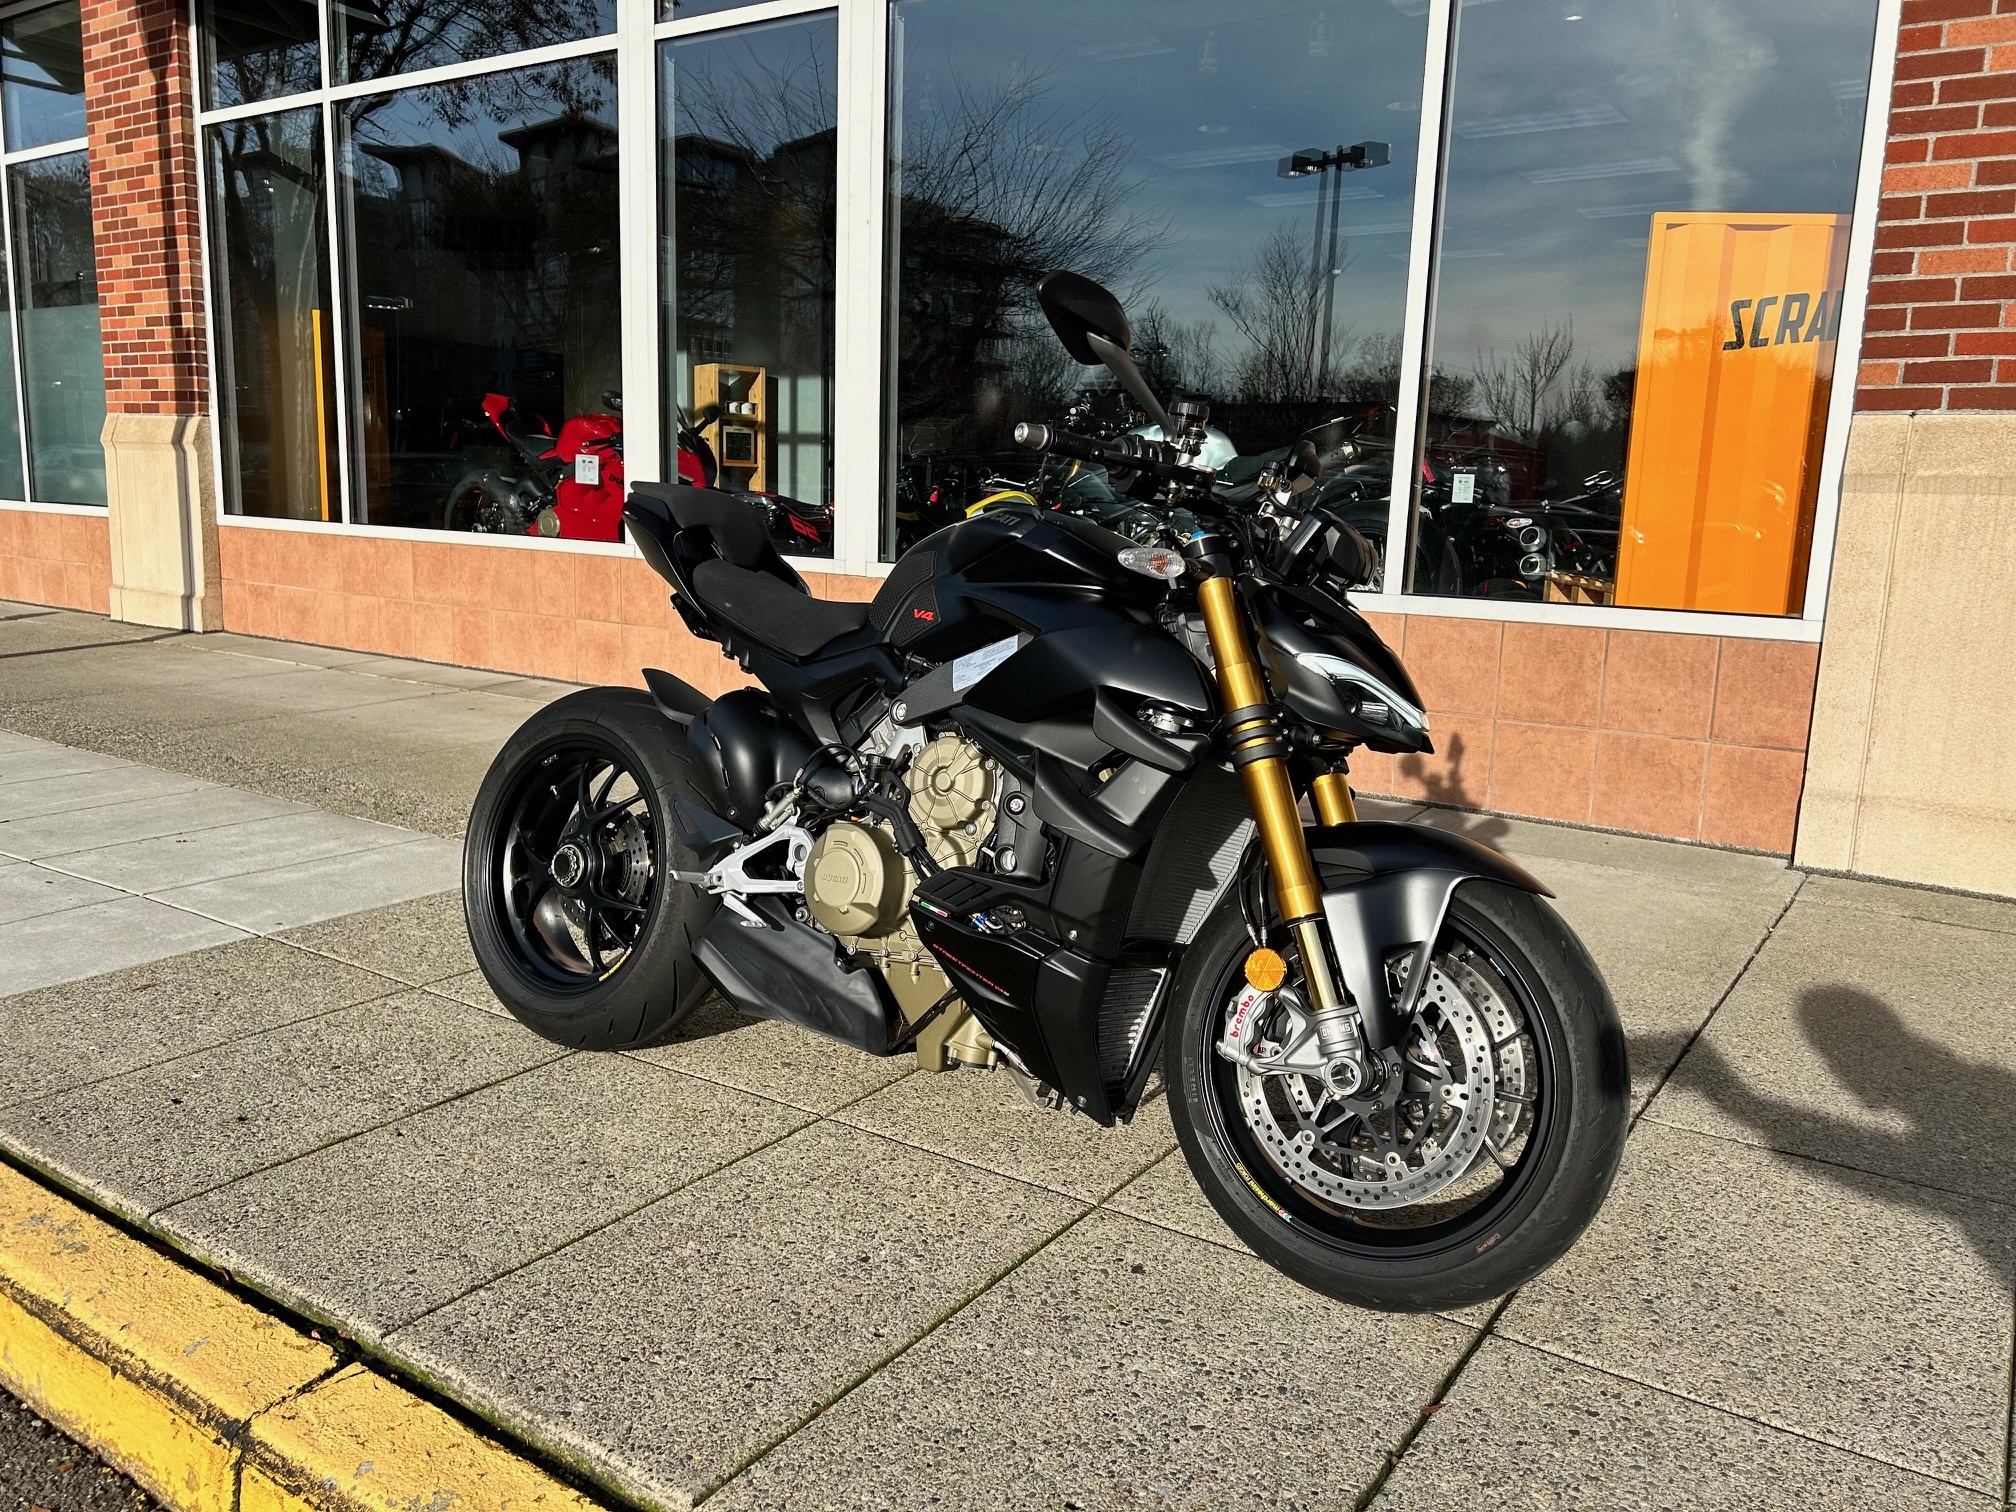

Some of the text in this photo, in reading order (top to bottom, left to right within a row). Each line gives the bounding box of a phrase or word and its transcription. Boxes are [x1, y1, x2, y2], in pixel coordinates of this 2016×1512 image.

[989, 512, 1022, 527] CATI
[913, 608, 935, 621] V4
[821, 872, 849, 884] DUCATI
[932, 942, 994, 988] STREETFIGHTER
[1230, 994, 1254, 1039] brembo
[1321, 1022, 1351, 1037] ÖHNS
